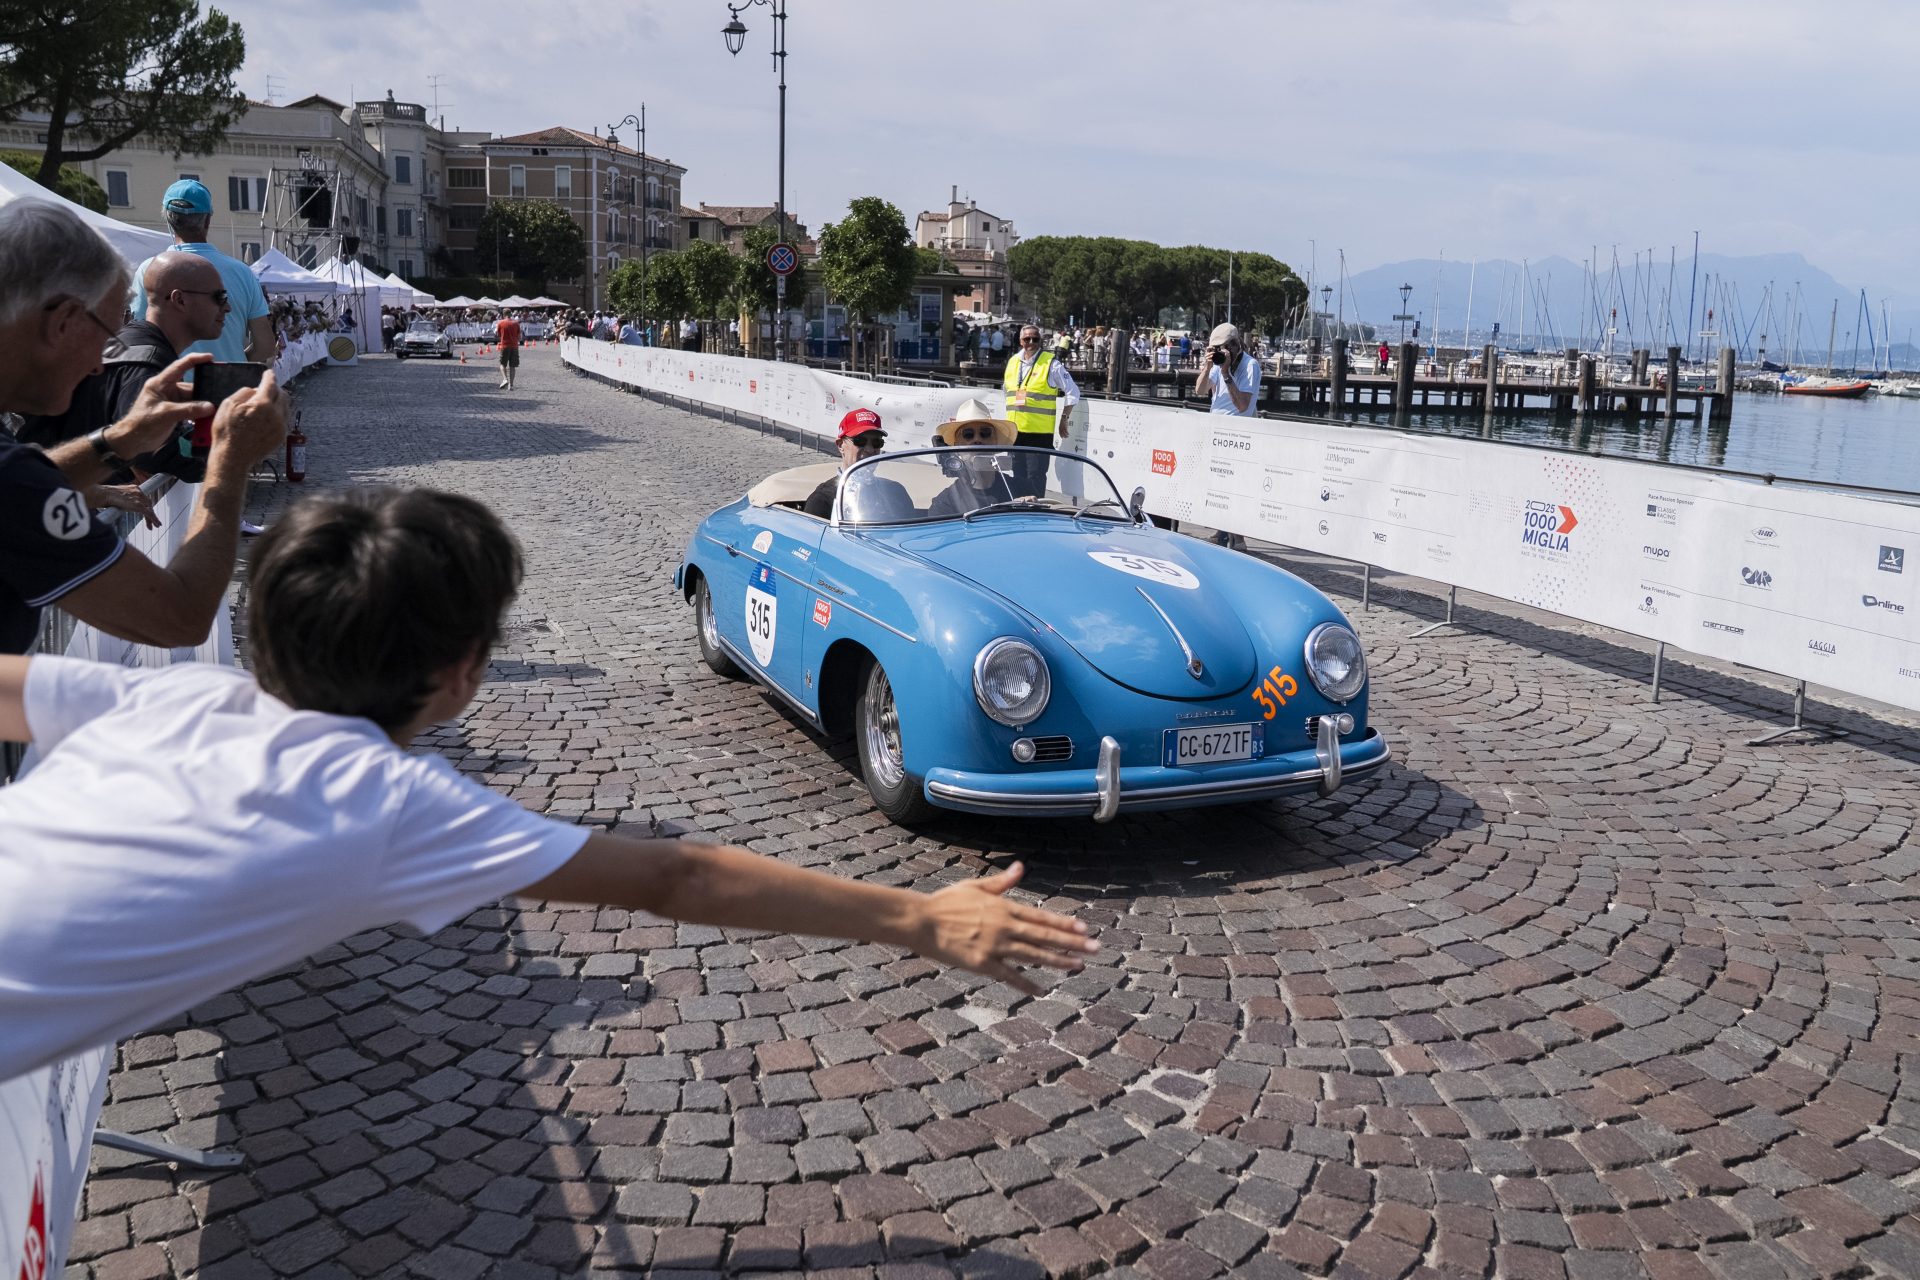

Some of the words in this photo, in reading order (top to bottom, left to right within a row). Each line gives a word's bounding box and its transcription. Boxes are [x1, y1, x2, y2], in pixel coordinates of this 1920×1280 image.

[1212, 438, 1251, 451] CHOPARD
[1154, 452, 1172, 462] 1000
[1152, 462, 1172, 473] MIGLIA
[1677, 498, 1695, 506] Sponsor
[51, 491, 85, 536] 27
[1657, 506, 1677, 514] CLASSIC
[1525, 511, 1557, 531] 1000
[1522, 528, 1569, 552] MIGLIA
[1643, 545, 1670, 557] mupa
[1110, 555, 1182, 577] 315
[1652, 586, 1665, 594] Friend
[817, 602, 829, 613] 1000
[1862, 595, 1905, 612] Online
[750, 597, 770, 640] 315
[1808, 639, 1837, 655] GAGGIA
[1251, 665, 1299, 720] 315
